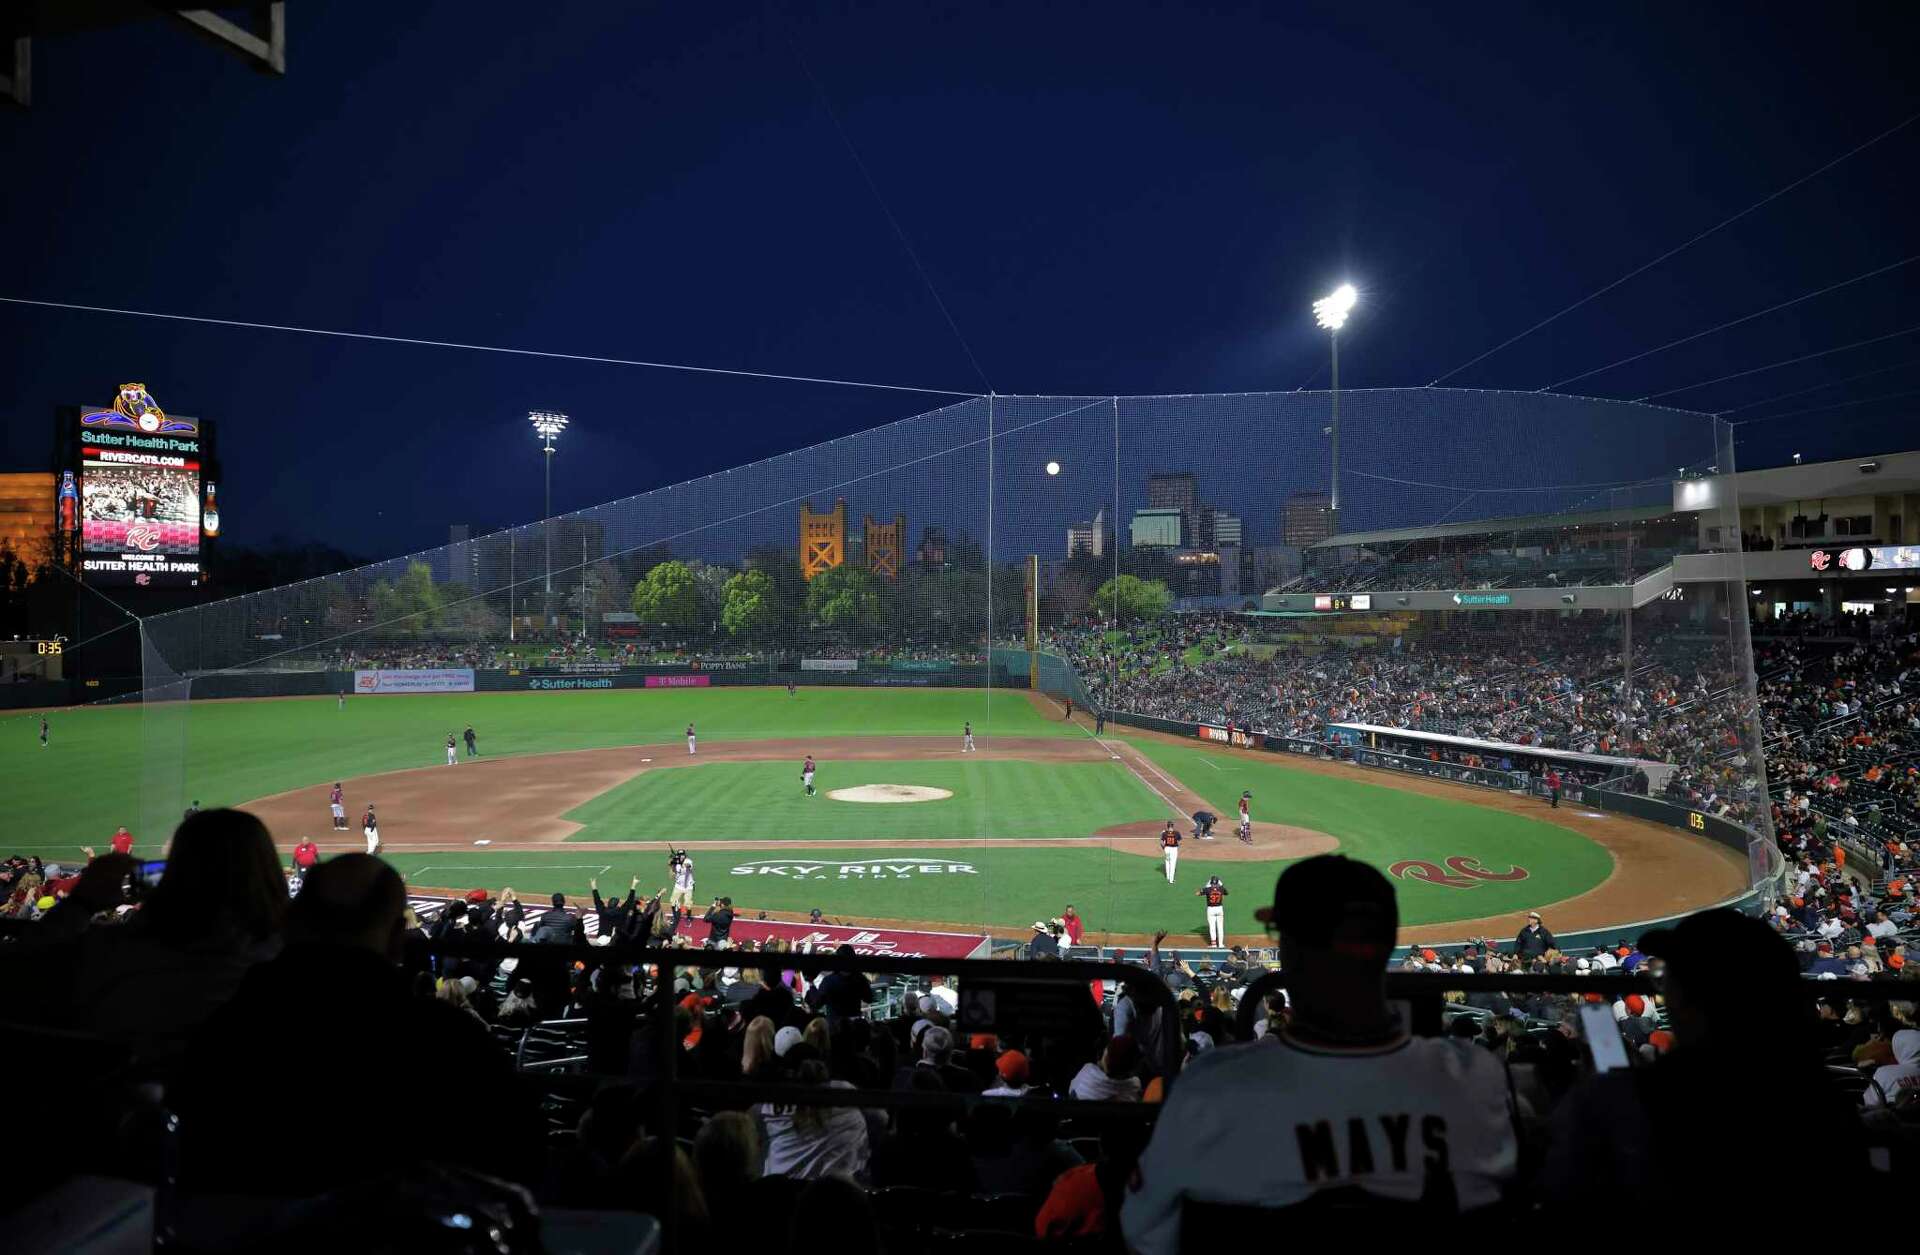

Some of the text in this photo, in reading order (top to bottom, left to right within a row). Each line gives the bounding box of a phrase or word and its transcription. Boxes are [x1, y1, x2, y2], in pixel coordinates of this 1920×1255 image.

[81, 430, 199, 452] Sutter Health Park
[100, 452, 185, 466] RIVERCATS.COM
[83, 560, 200, 573] SUTTER HEALTH PARK
[1463, 593, 1510, 605] Sutter Health
[38, 642, 62, 655] 0:35
[541, 677, 613, 689] Sutter Health
[730, 864, 980, 875] SKY RIVER
[1294, 1114, 1449, 1182] MAYS
